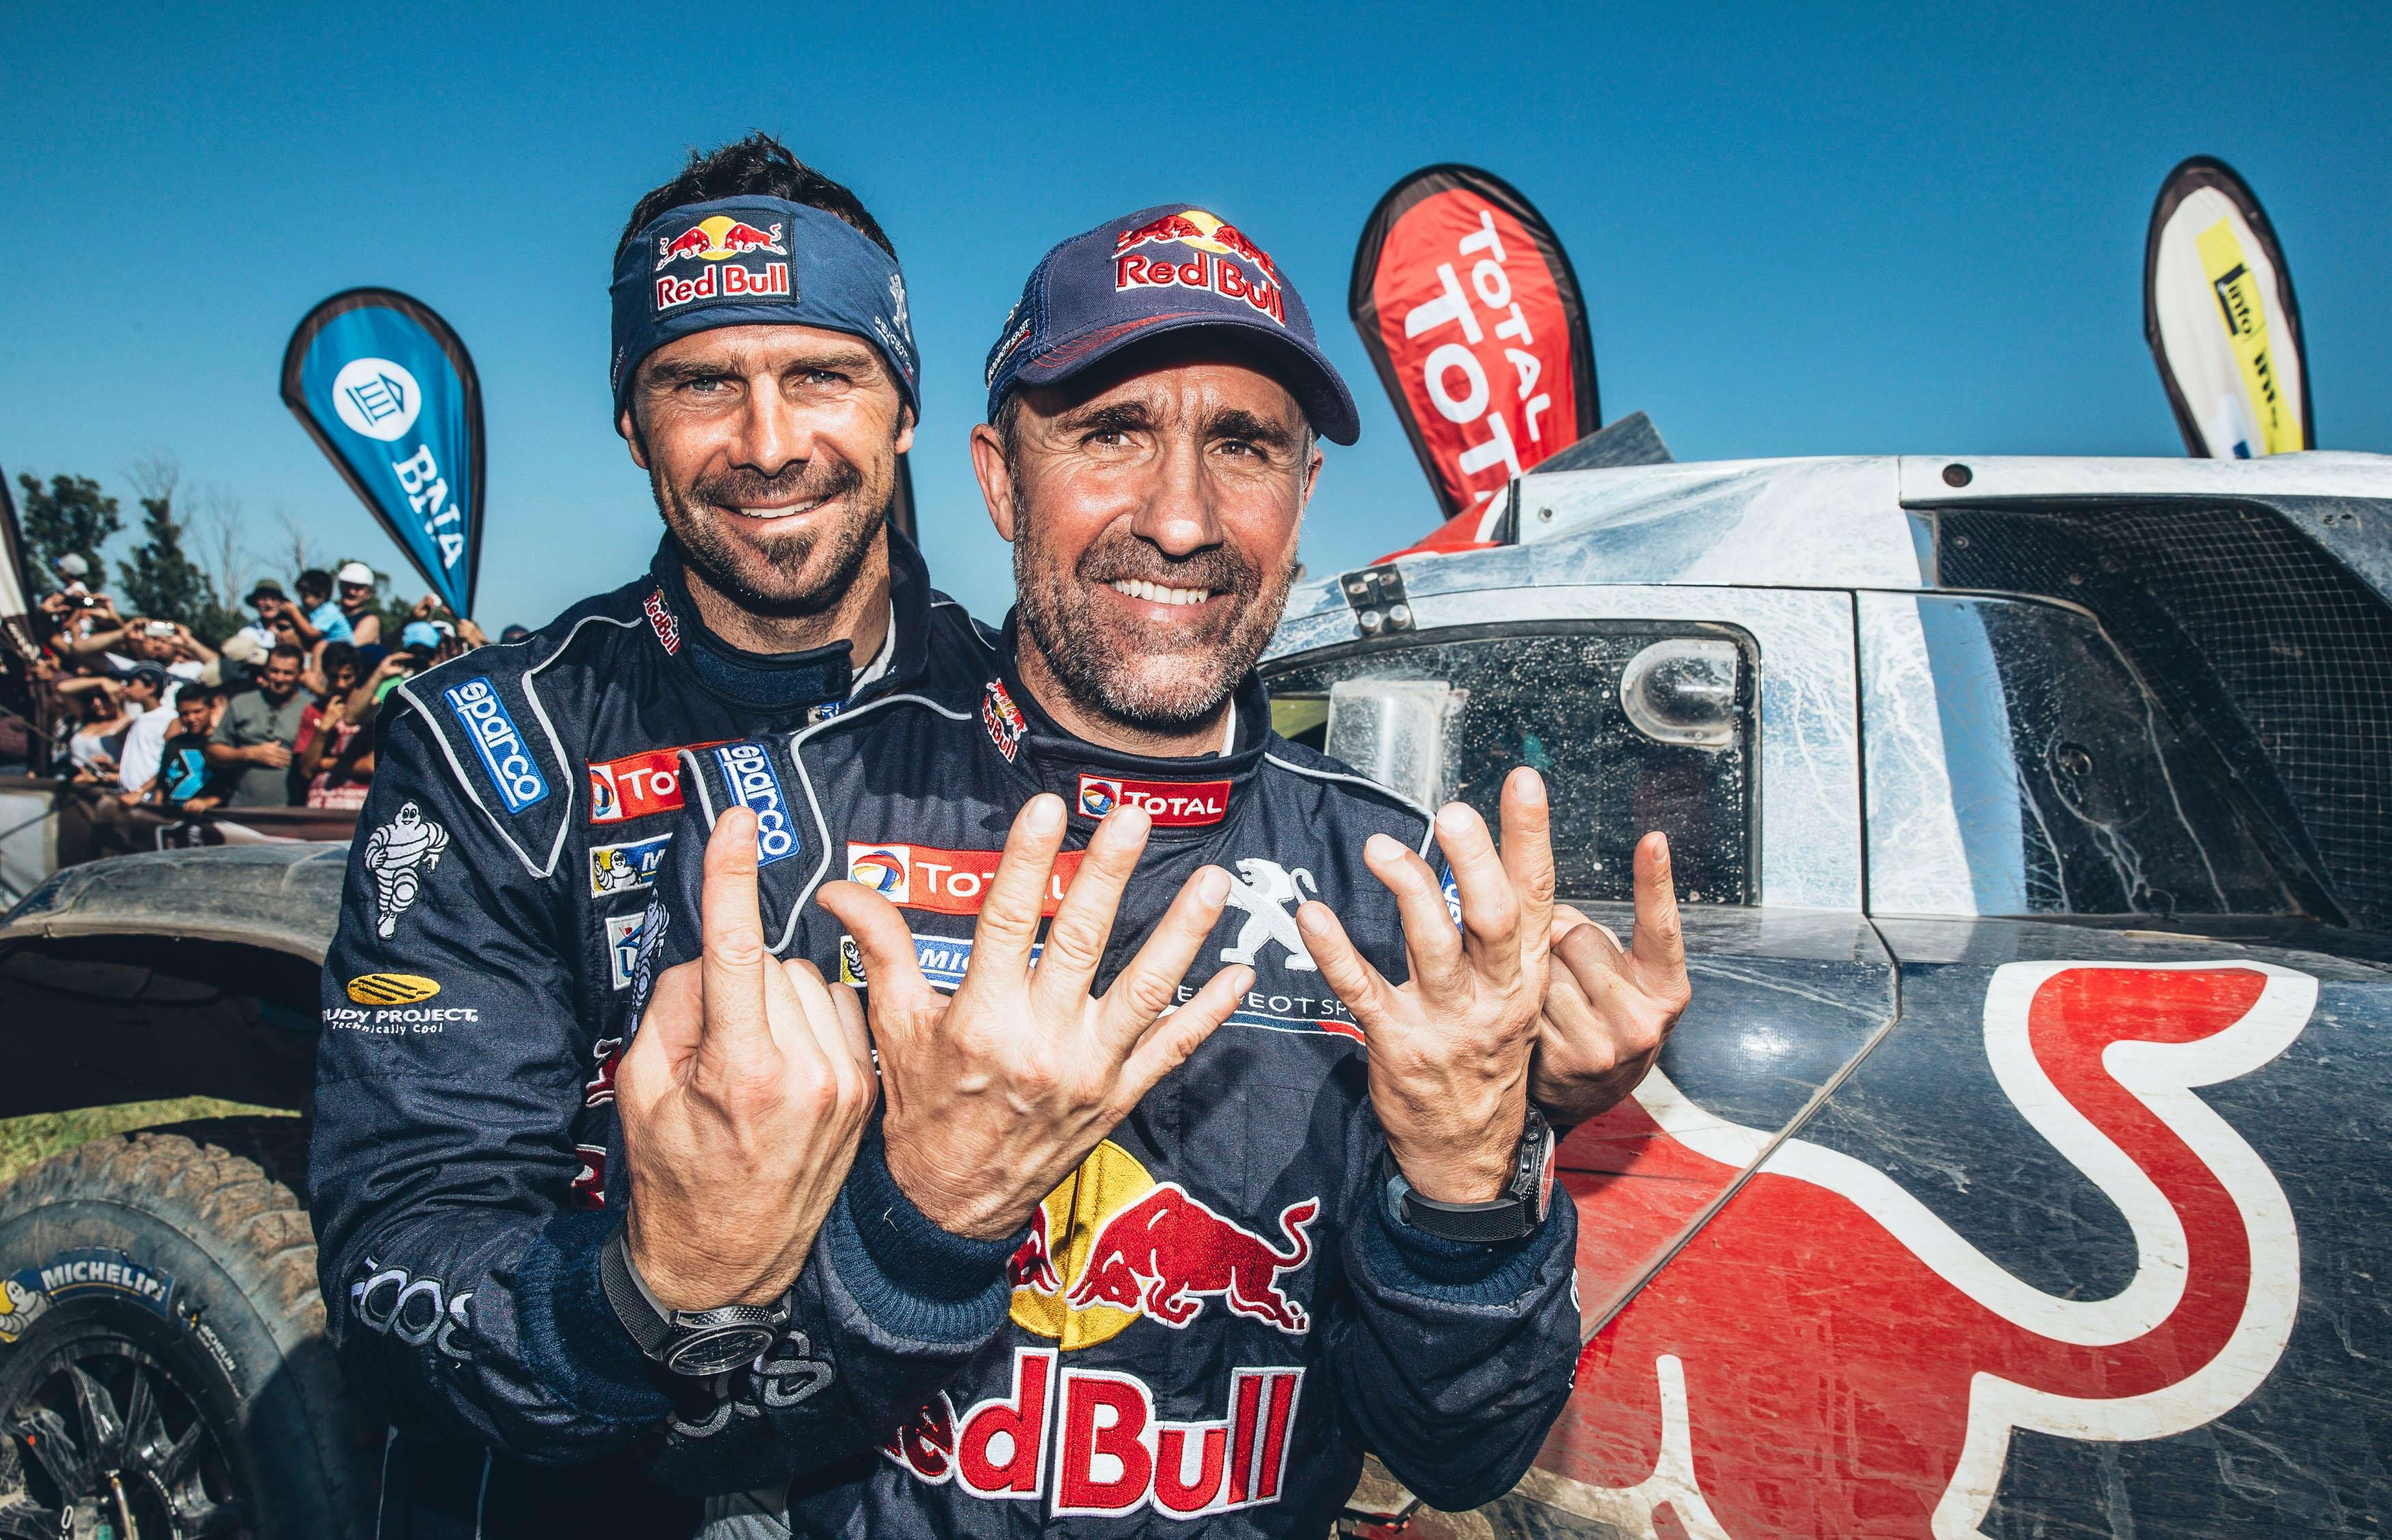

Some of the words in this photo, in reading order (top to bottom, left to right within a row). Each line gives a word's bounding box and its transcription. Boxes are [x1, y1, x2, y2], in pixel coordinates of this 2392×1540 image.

[657, 264, 716, 311] Red
[723, 262, 791, 296] Bull
[1116, 252, 1211, 292] Red
[1215, 258, 1286, 327] Bull
[1459, 210, 1551, 442] TOTAL
[1404, 262, 1525, 502] TOT
[392, 444, 464, 569] BNA
[655, 616, 681, 655] Bull
[457, 682, 541, 801] sparco
[992, 715, 1018, 763] Bull
[724, 745, 791, 855] sparco
[1124, 791, 1223, 816] TOTAL
[332, 1021, 407, 1035] Technically
[375, 1008, 478, 1023] PROJECT
[41, 1261, 166, 1302] MICHELIN
[875, 1347, 1059, 1499] ed
[1052, 1366, 1306, 1520] Bull
